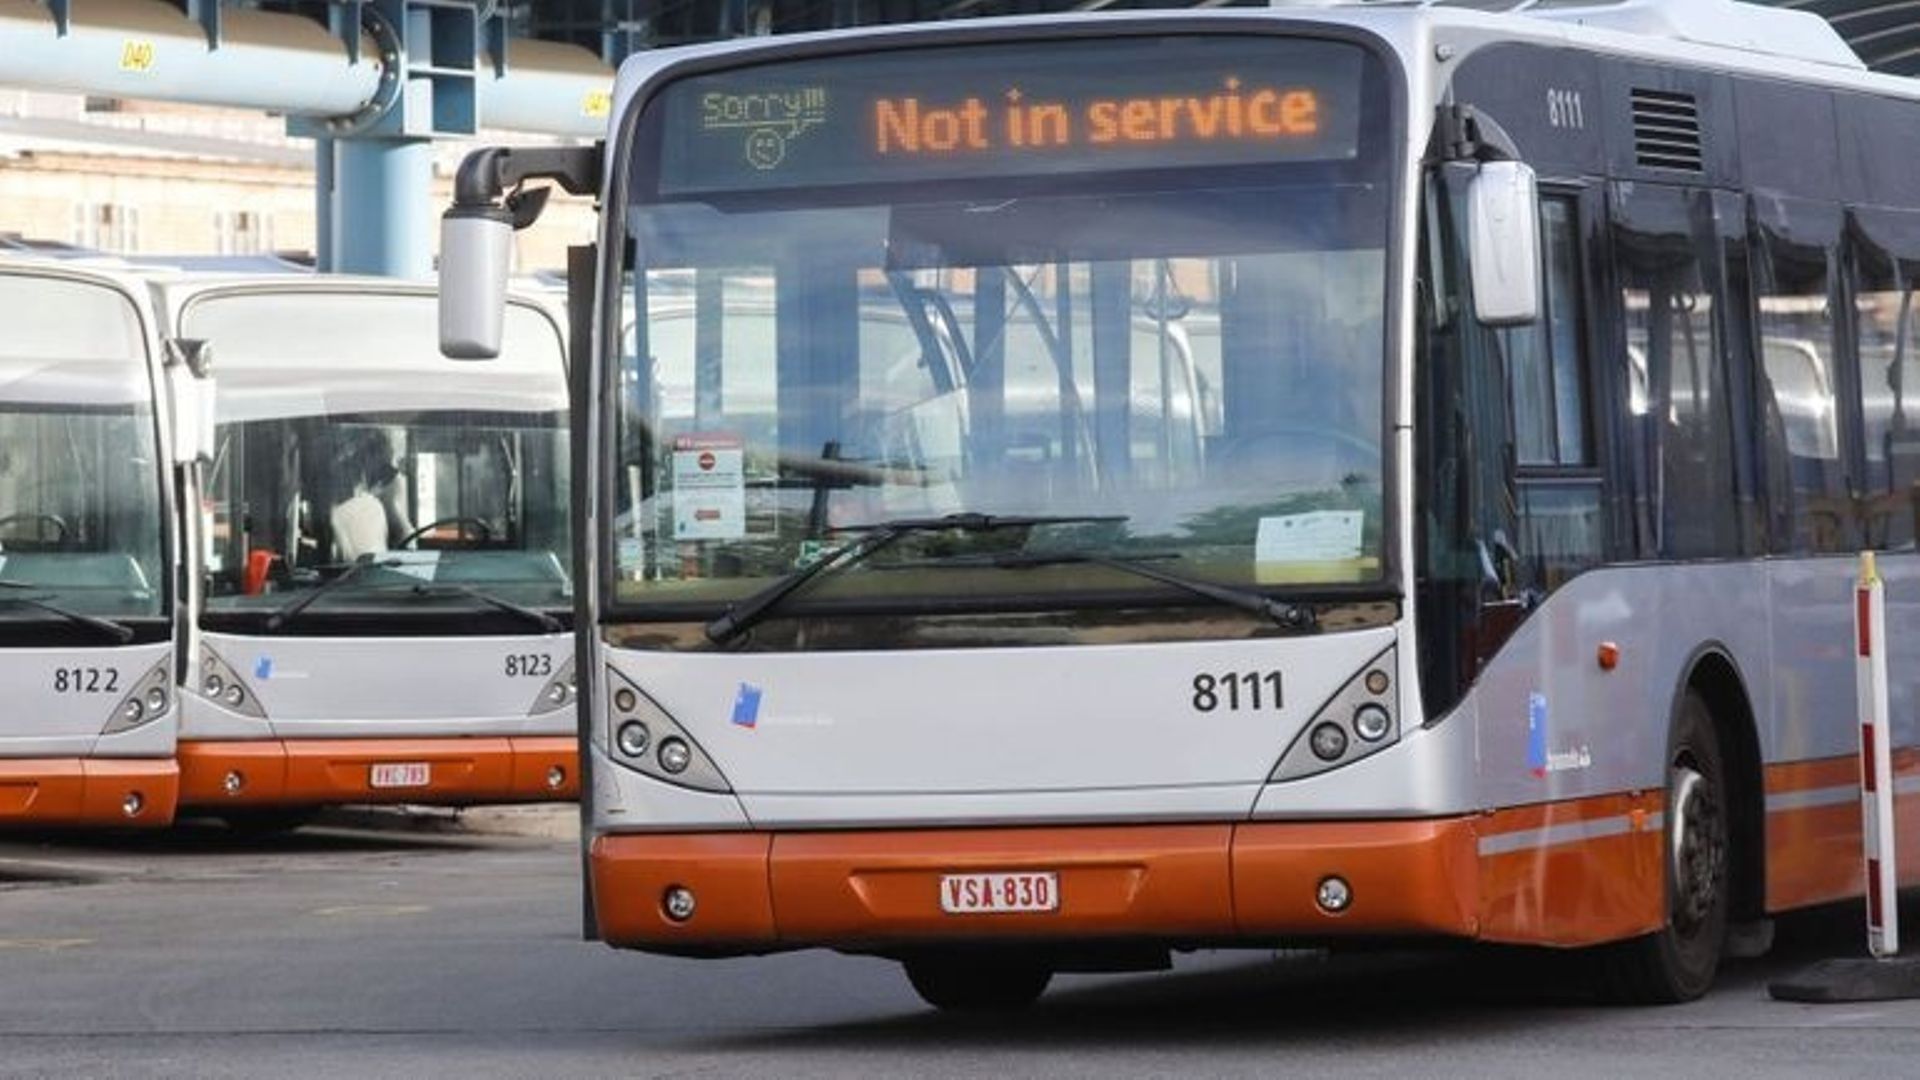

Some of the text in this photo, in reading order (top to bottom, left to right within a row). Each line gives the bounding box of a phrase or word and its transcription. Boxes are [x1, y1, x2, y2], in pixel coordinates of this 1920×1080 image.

[703, 88, 825, 121] Sorry!!!
[875, 77, 1318, 153] Not in service
[1547, 88, 1583, 128] 8111
[55, 668, 118, 692] 8122
[505, 654, 551, 677] 8123
[1193, 670, 1283, 712] 8111
